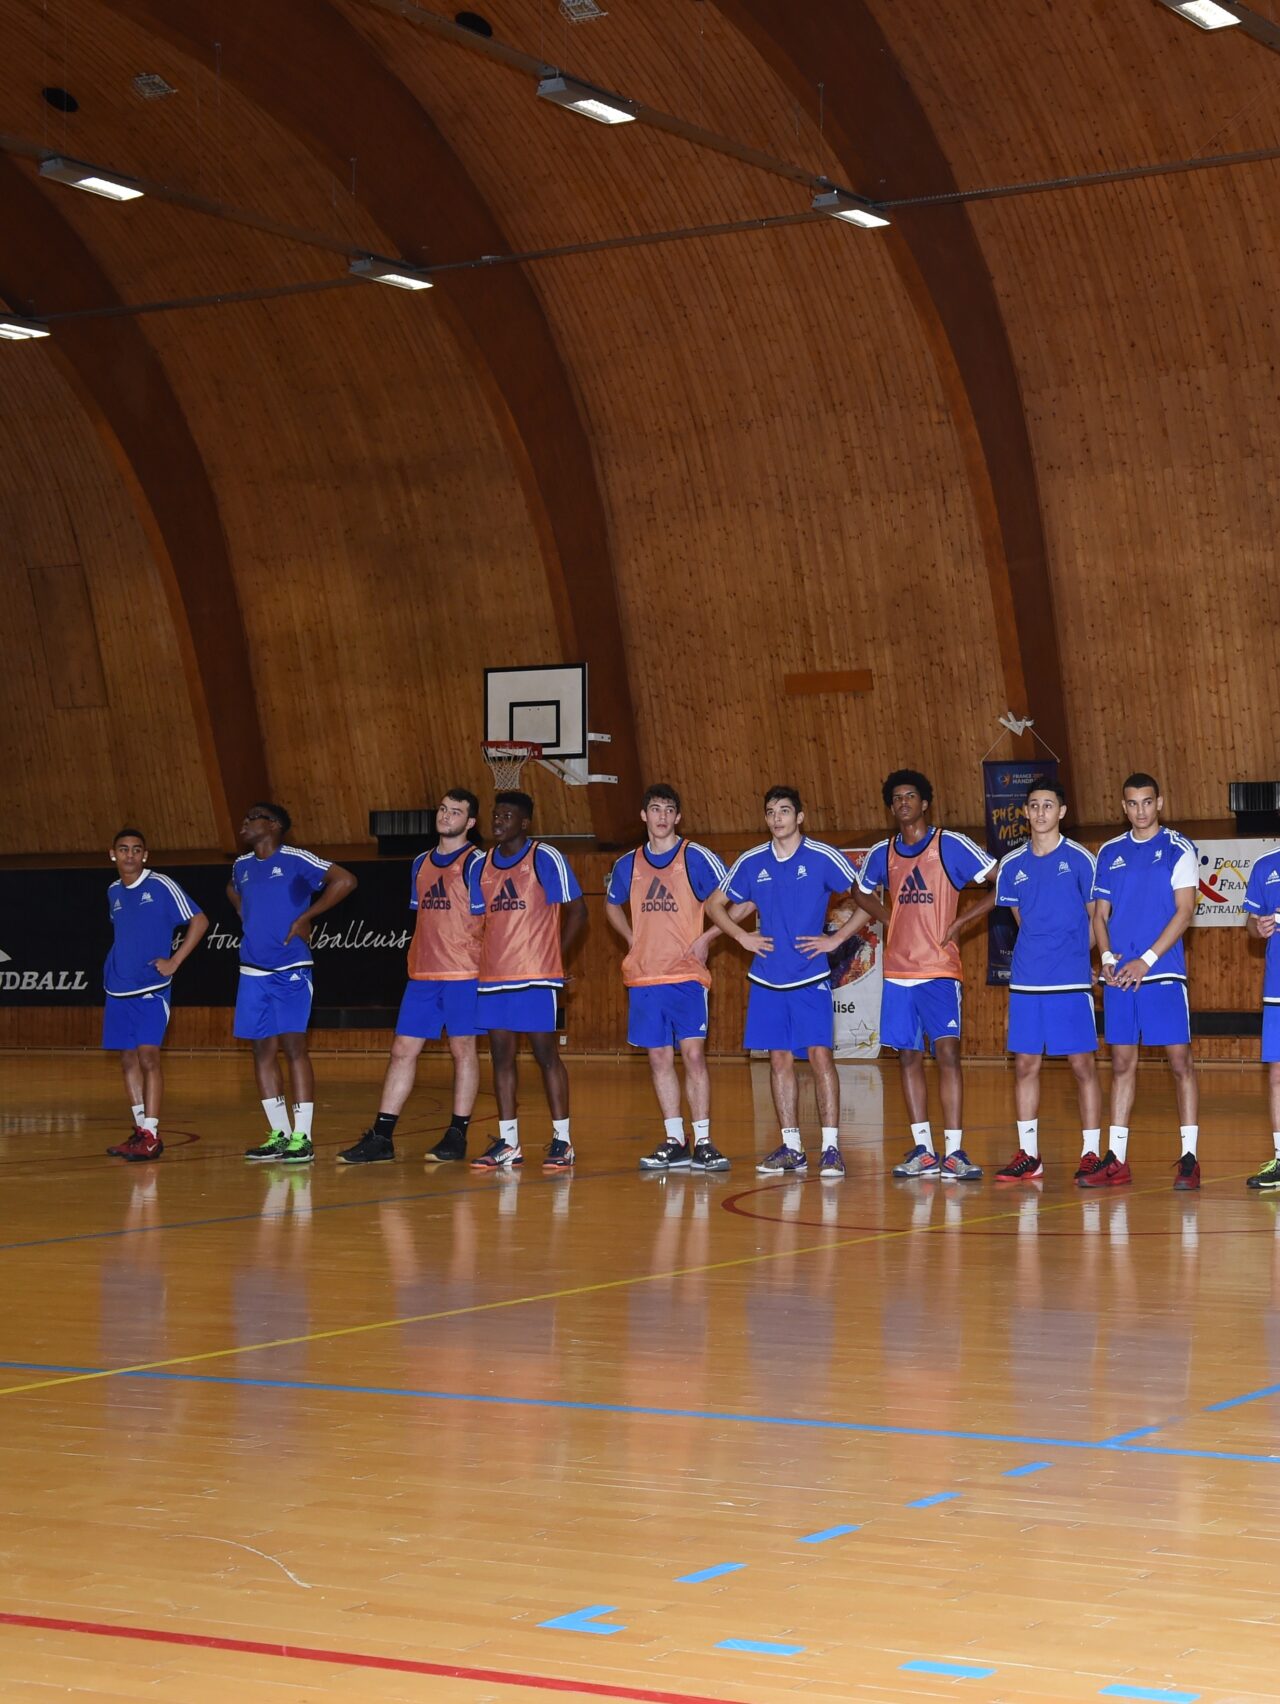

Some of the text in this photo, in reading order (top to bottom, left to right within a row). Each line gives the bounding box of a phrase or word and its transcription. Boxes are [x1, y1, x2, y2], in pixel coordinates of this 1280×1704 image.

[992, 803, 1026, 825] PHÉN
[998, 822, 1031, 840] MÉN
[1213, 857, 1250, 870] ECOLE
[1217, 878, 1249, 892] FRAN
[898, 889, 934, 904] adidas
[421, 898, 451, 910] adidas
[490, 899, 526, 913] adidas
[1195, 903, 1249, 916] ENTRAINE
[207, 922, 241, 950] tou
[309, 919, 413, 950] balleurs
[0, 970, 89, 990] DBALL
[833, 1000, 856, 1014] lisé
